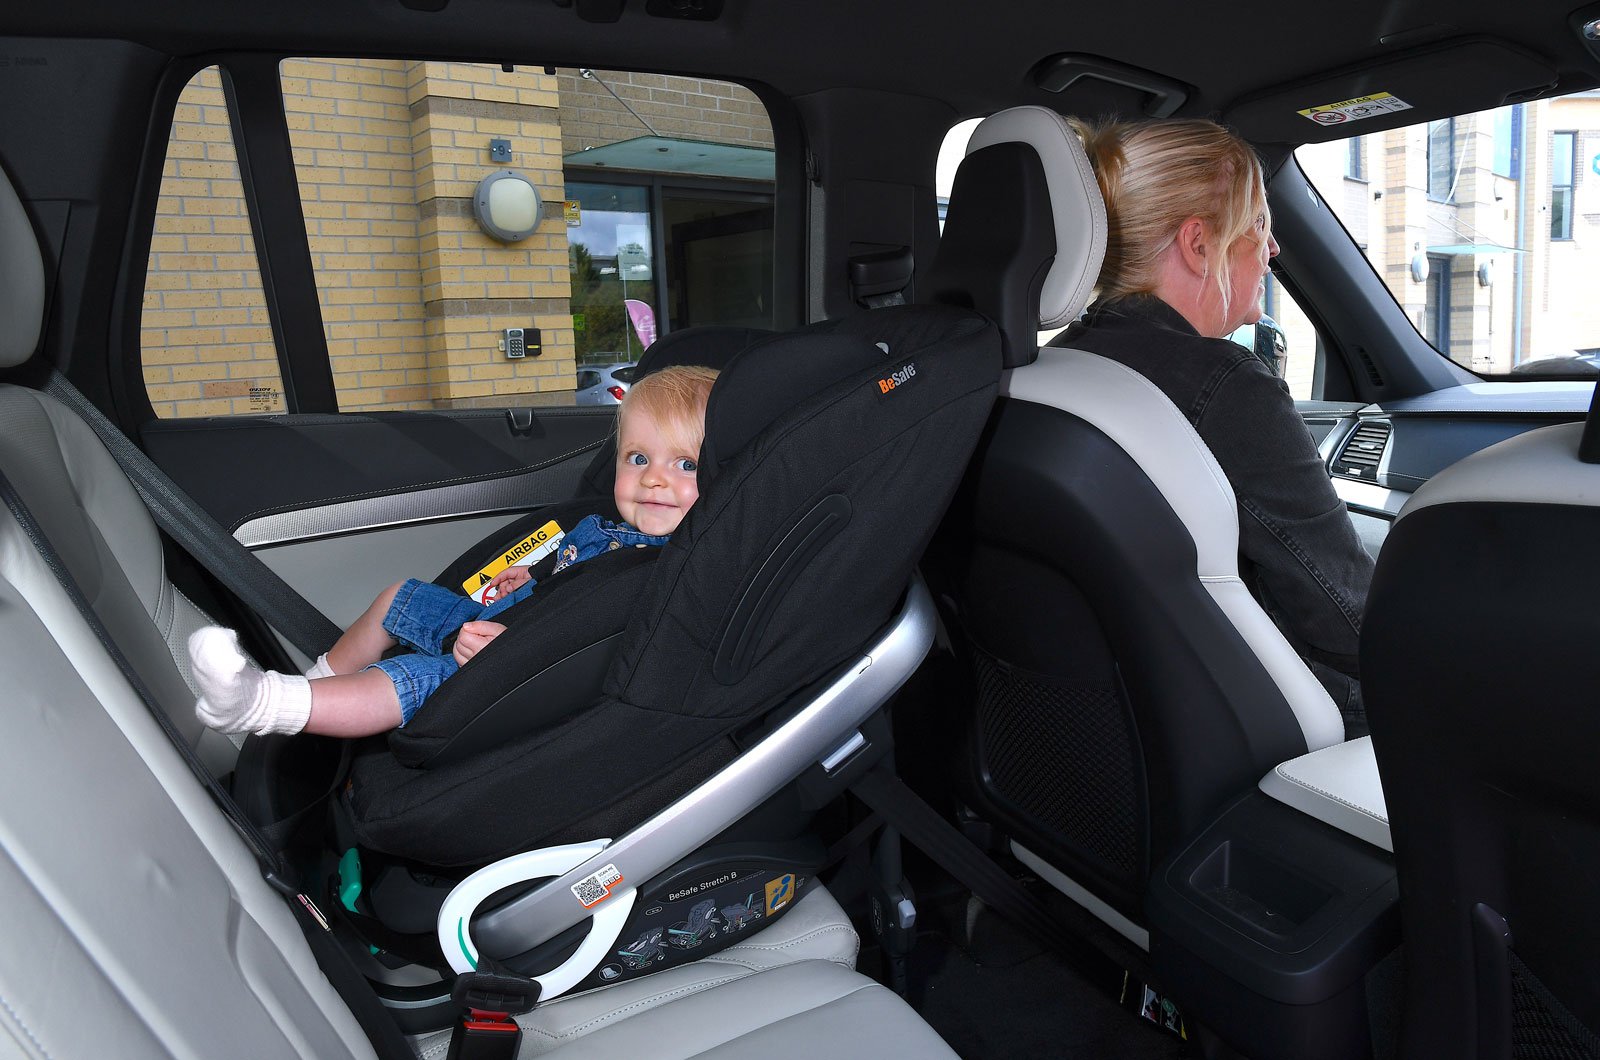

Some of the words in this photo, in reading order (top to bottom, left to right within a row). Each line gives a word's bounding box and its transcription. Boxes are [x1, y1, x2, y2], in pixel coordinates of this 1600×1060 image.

[1330, 96, 1371, 109] AIRBAG
[498, 145, 505, 155] 9
[878, 364, 916, 394] BeSafe
[505, 530, 548, 565] AIRBAG
[668, 886, 698, 901] BeSafe
[700, 874, 729, 890] Stretch
